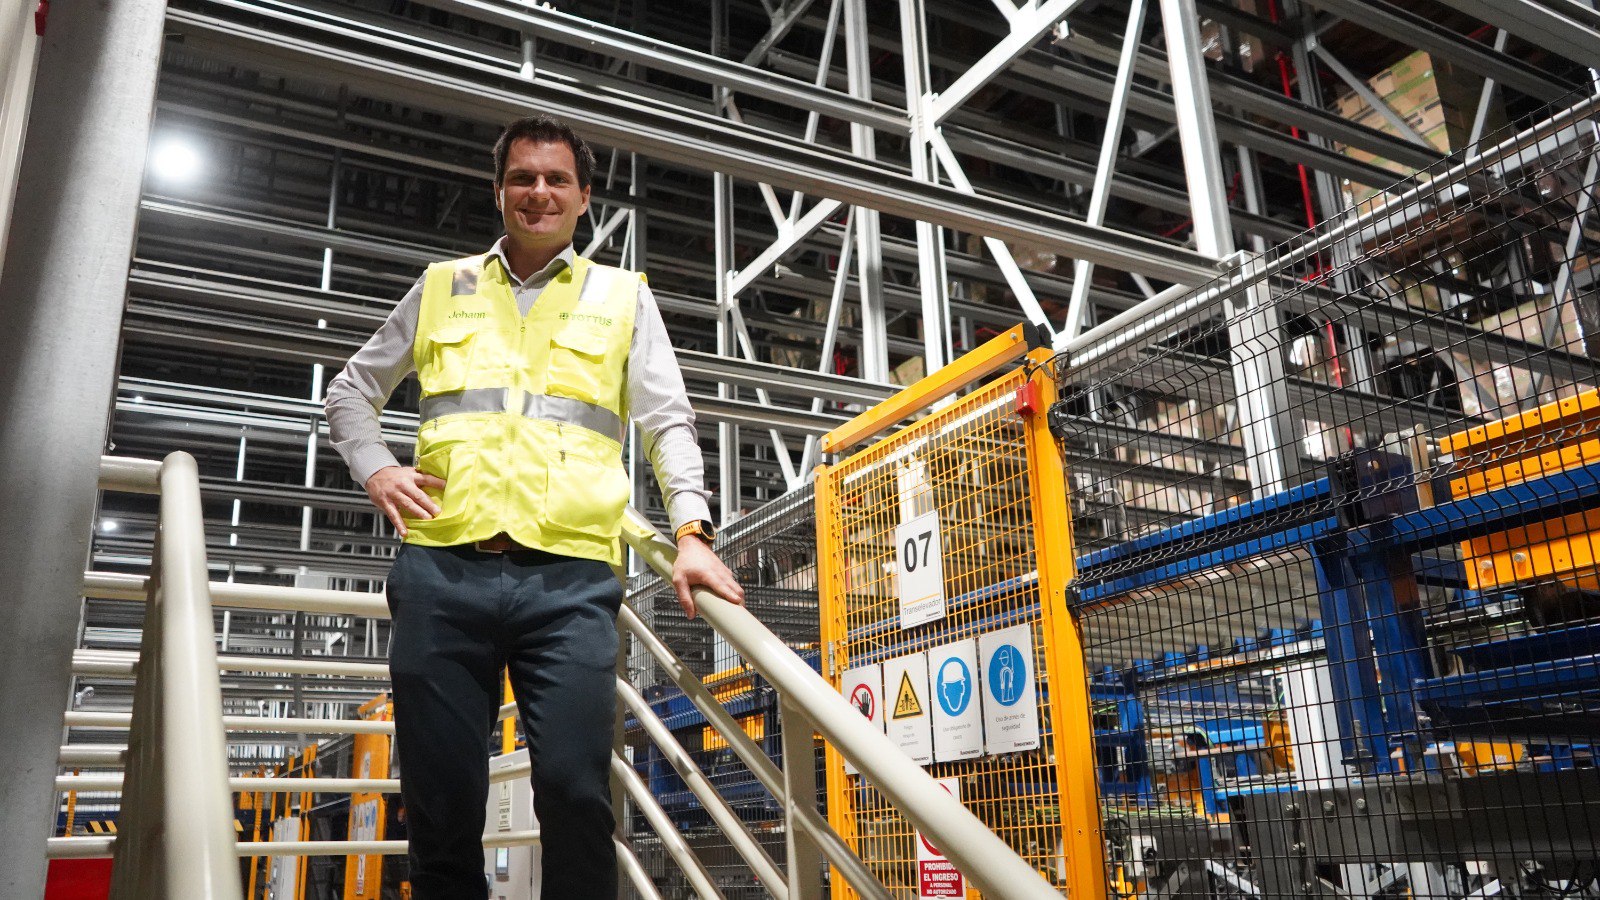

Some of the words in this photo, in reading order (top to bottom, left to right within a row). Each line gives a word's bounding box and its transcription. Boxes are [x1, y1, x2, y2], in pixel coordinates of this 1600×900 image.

[448, 310, 486, 319] Johann
[570, 313, 612, 327] TOTTUS
[904, 530, 932, 573] 07
[923, 873, 931, 881] EL
[932, 873, 958, 881] INGRESO
